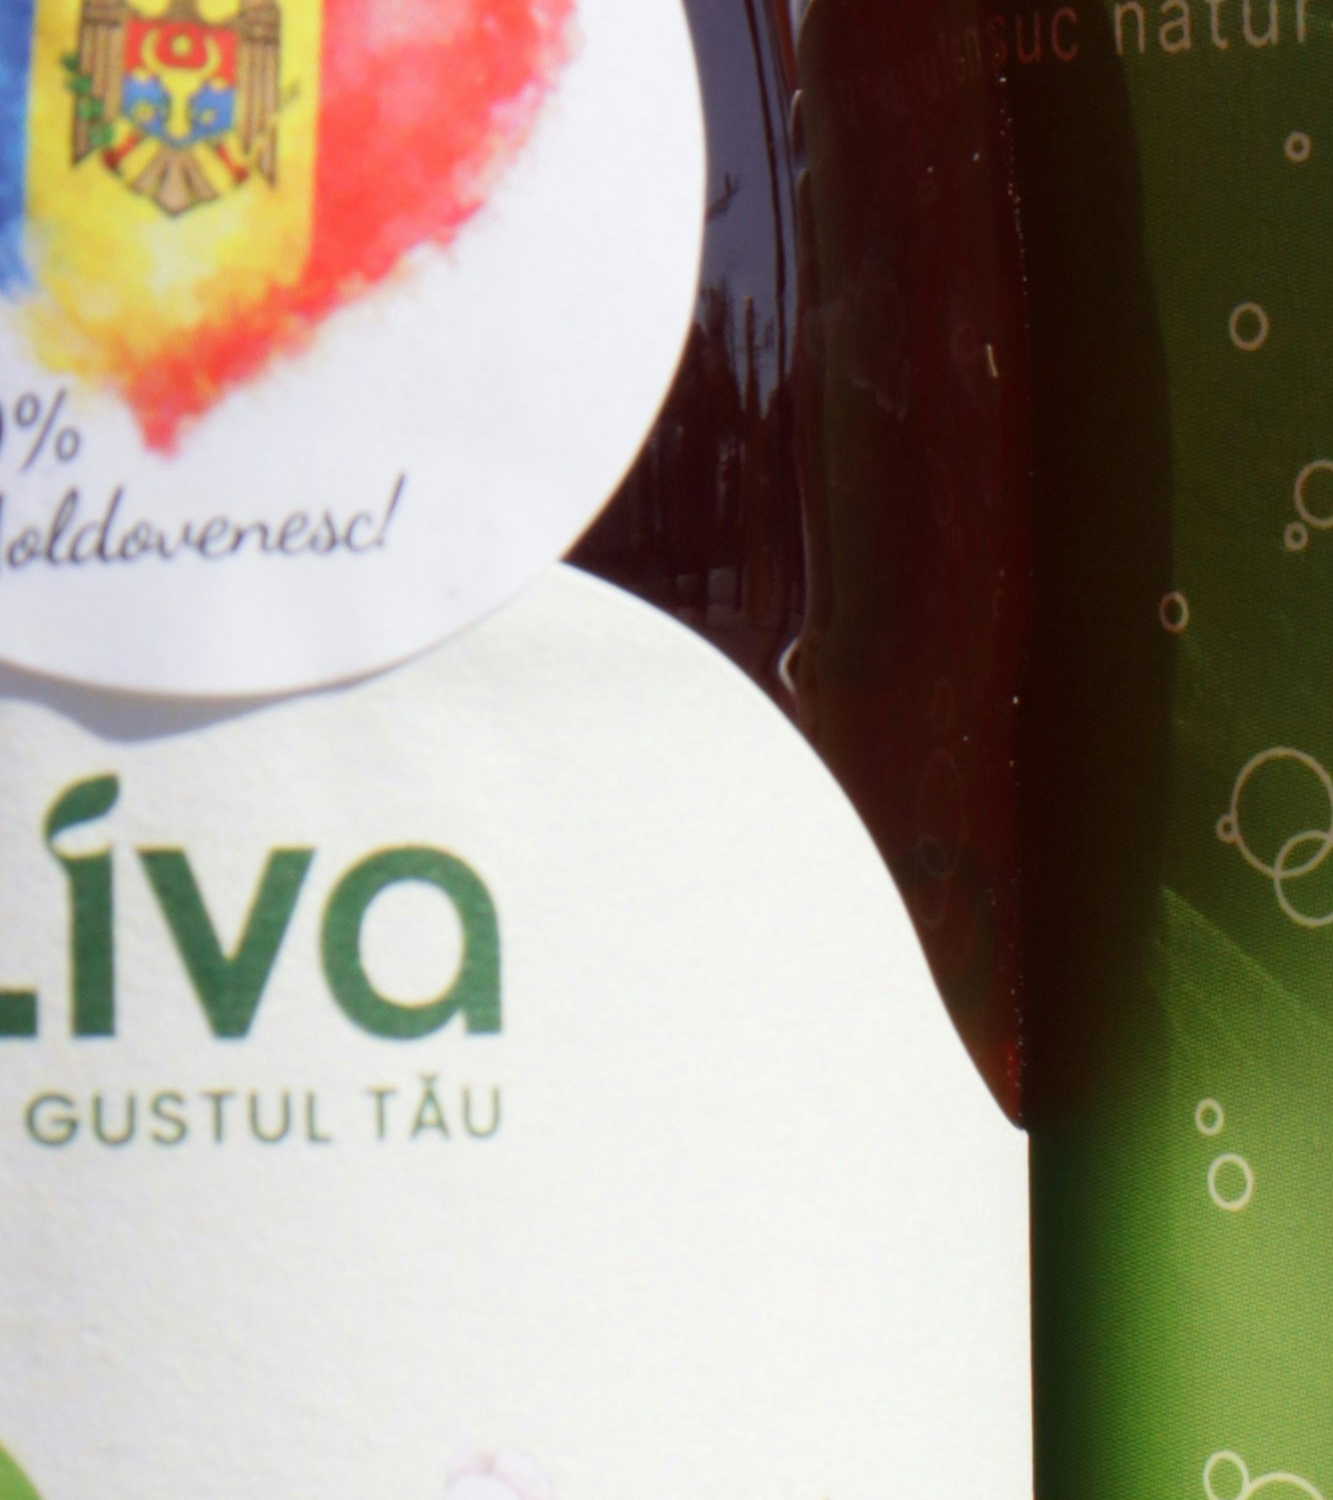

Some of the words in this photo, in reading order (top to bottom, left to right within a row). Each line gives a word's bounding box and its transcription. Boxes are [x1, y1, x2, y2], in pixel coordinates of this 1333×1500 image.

[0, 470, 408, 571] oldovenesc!
[23, 1089, 333, 1148] GUSTUL
[366, 1070, 503, 1142] TĂU
